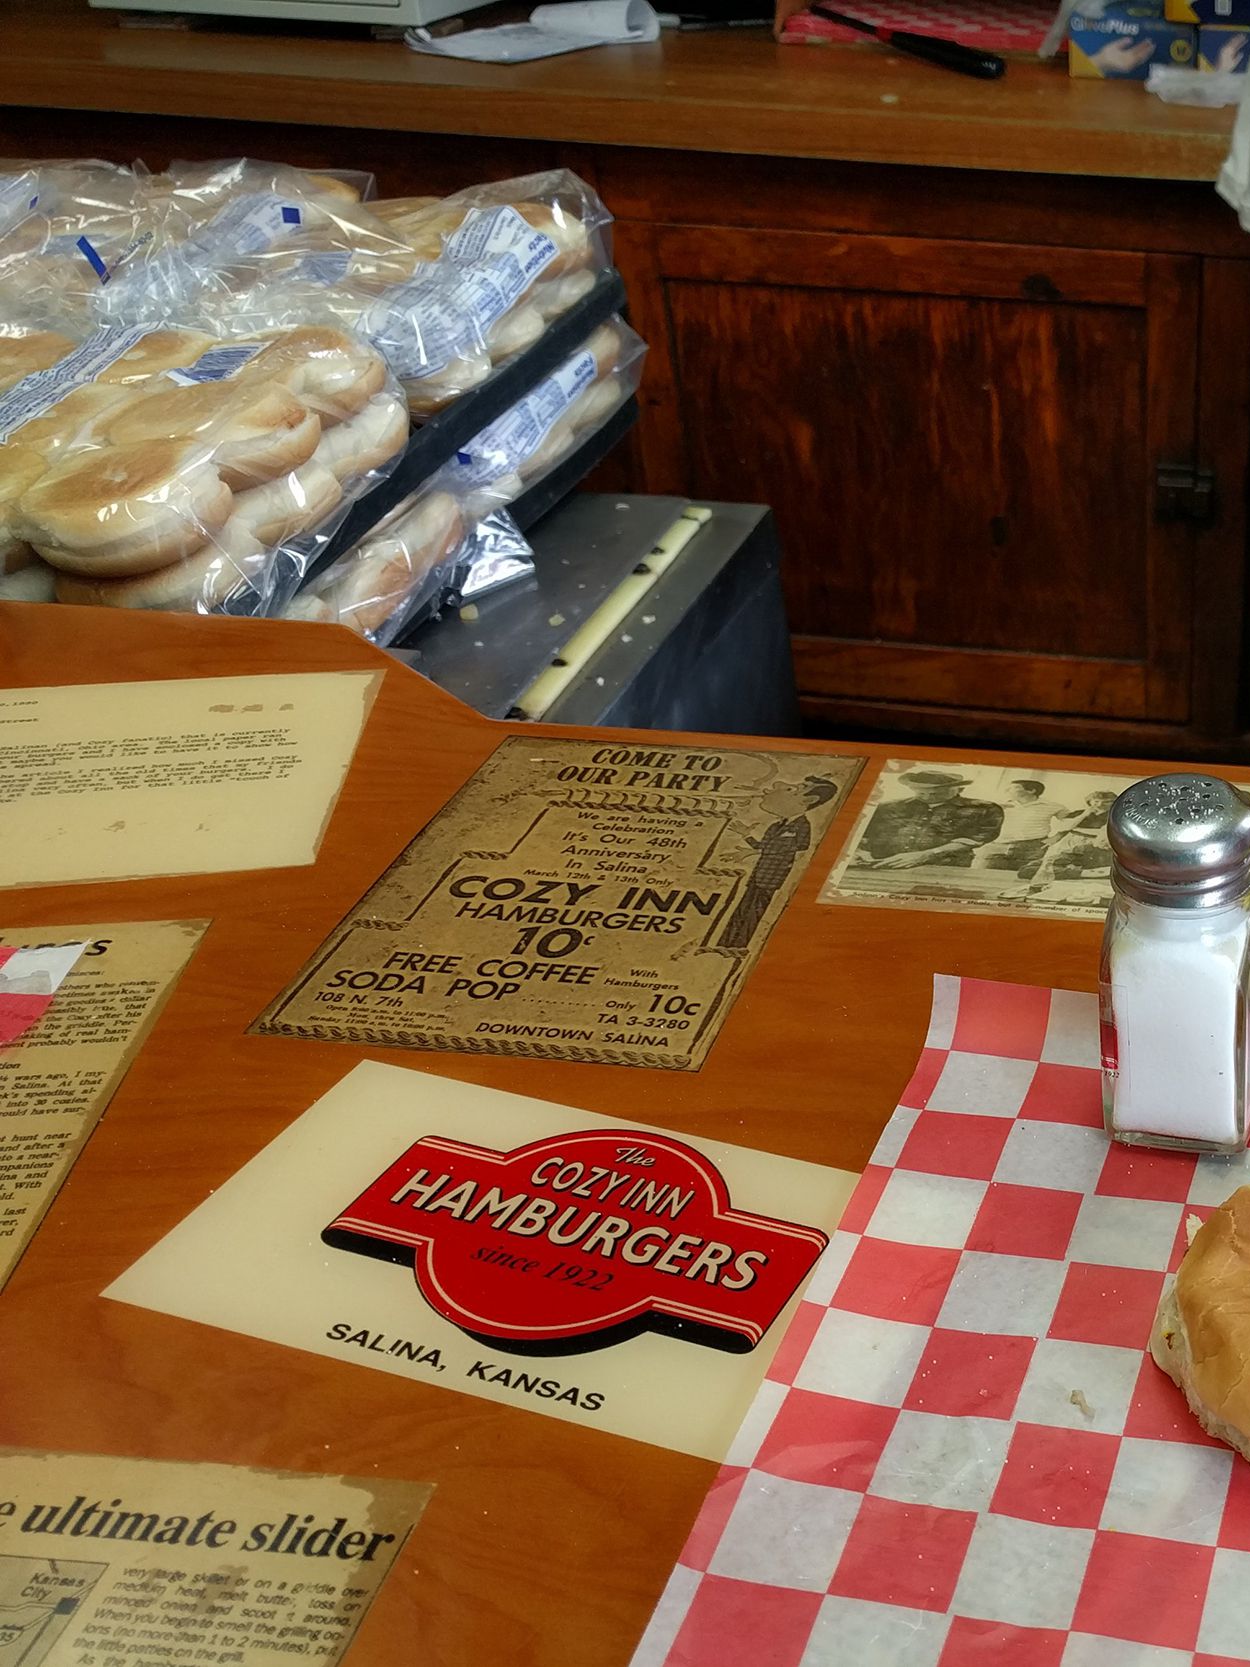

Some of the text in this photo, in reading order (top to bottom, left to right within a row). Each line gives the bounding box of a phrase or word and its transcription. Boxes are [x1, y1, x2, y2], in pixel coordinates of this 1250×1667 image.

[592, 749, 722, 772] COME TO
[556, 766, 732, 792] OUR PARTY
[578, 812, 600, 820] We
[607, 814, 630, 822] are
[637, 815, 688, 828] having
[592, 822, 675, 835] Celebration
[562, 831, 688, 848] It's Our 48th
[561, 845, 672, 863] Anniversary
[565, 859, 648, 874] In Salina
[524, 869, 558, 878] March
[567, 872, 591, 880] 12th
[614, 875, 639, 884] 13th
[646, 878, 674, 888] Only
[449, 875, 722, 916] COZY INN
[455, 902, 686, 934] HAMBURGERS
[382, 951, 600, 984] FREE COFFEE
[630, 968, 659, 979] With
[326, 970, 520, 1000] SODA POP
[603, 978, 680, 991] Hamburgers
[314, 992, 403, 1008] 108 N. 7th
[605, 1000, 636, 1012] Only
[596, 1014, 691, 1030] TA 3-3280
[475, 1022, 669, 1047] DOWNTOWN SALINA
[615, 1146, 656, 1167] The
[531, 1156, 696, 1218] COZY INN
[390, 1167, 769, 1290] HAMBURGERS
[470, 1244, 614, 1292] since 1922
[326, 1322, 606, 1412] SALINA, KANSAS
[20, 1495, 396, 1561] ultimate slider
[30, 1572, 86, 1587] Kansas
[20, 1586, 52, 1600] City
